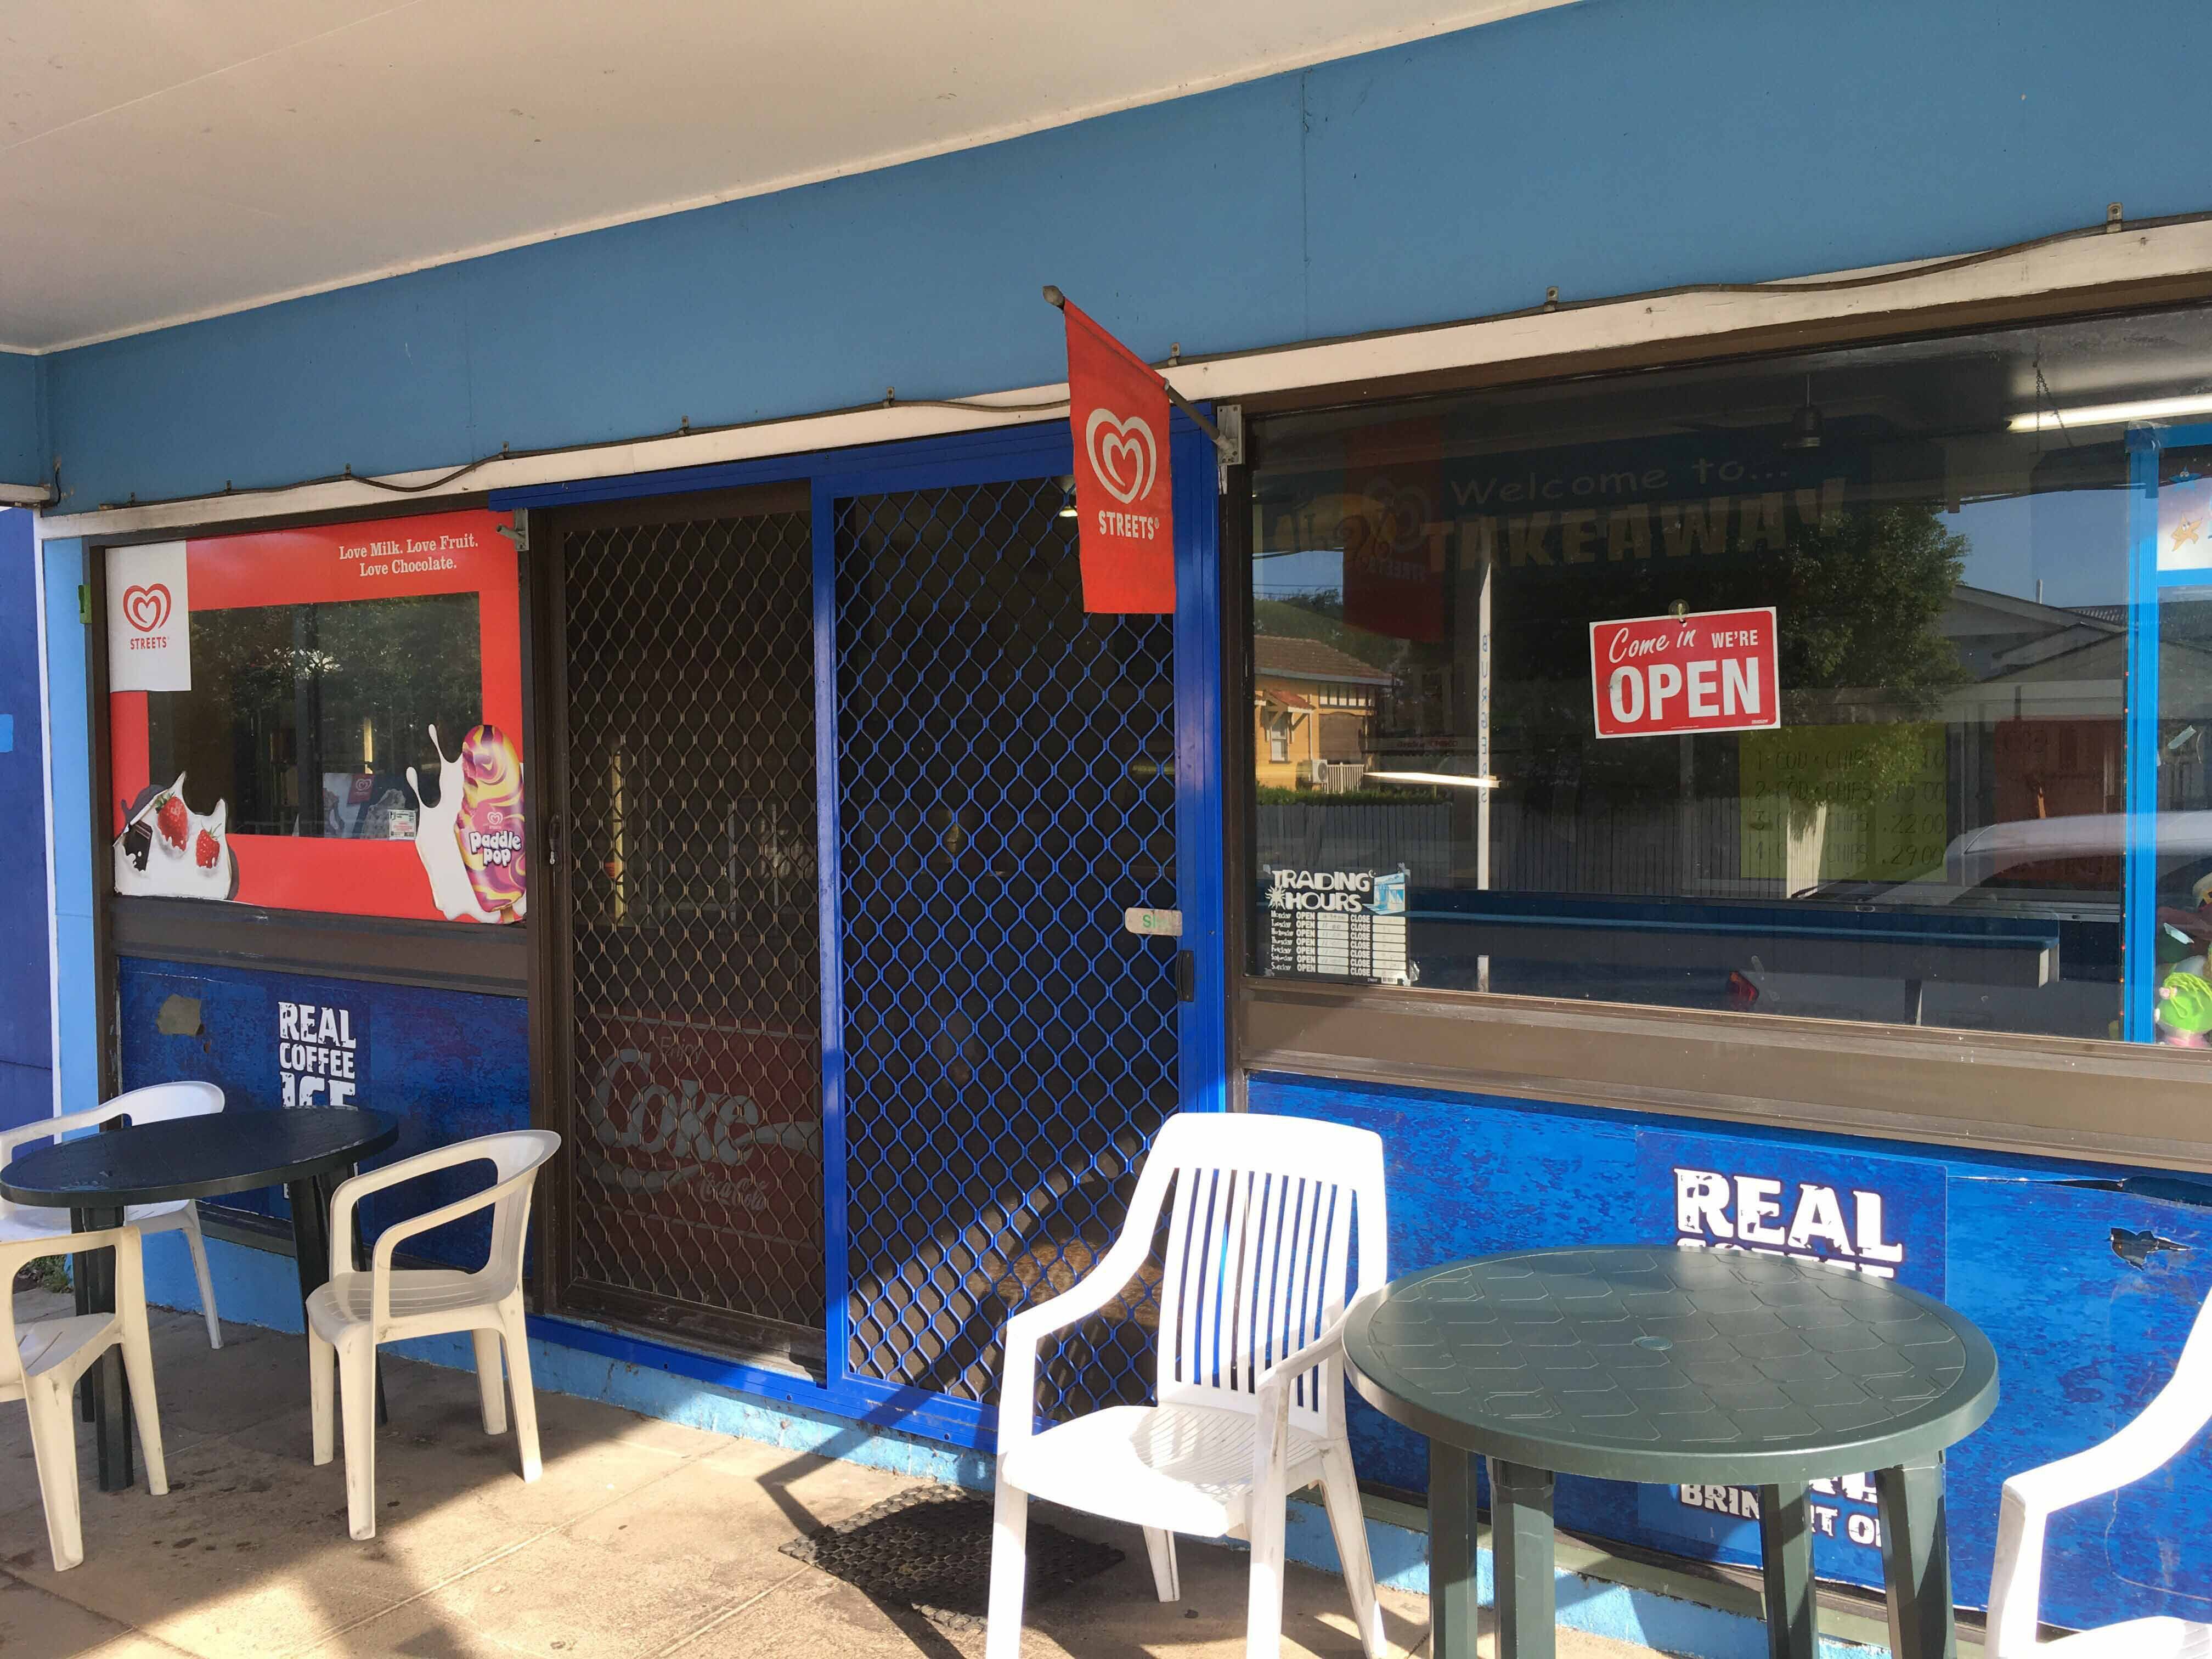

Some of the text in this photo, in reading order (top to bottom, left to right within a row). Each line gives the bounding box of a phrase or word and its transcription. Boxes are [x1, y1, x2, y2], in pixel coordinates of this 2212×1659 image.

[1451, 457, 1788, 507] Welcome to...
[1098, 510, 1155, 540] STREETS
[1421, 477, 1845, 571] TAKEAWAY
[339, 533, 478, 560] Love Milk. Love Fruit.
[359, 557, 457, 577] Love Chocolate.
[131, 636, 167, 650] STREETS
[1609, 622, 1758, 663] Come in WE'RE
[1609, 657, 1760, 723] OPEN
[1272, 870, 1370, 892] TRADING
[1285, 892, 1362, 913] HOURS
[1271, 910, 1291, 919] Monday
[1296, 911, 1316, 920] OPEN
[1350, 914, 1371, 923] CLOSE
[1271, 919, 1291, 928] Tuesday
[1296, 920, 1316, 929] OPEN
[1350, 923, 1371, 932] CLOSE
[1271, 936, 1293, 945] Thursday
[1296, 937, 1316, 946] OPEN
[1350, 940, 1371, 950] CLOSE
[1296, 929, 1316, 938] OPEN
[1350, 932, 1371, 941] CLOSE
[1271, 945, 1291, 953] Friday
[1296, 946, 1316, 955] OPEN
[1350, 950, 1371, 958] CLOSE
[1296, 955, 1316, 964] OPEN
[1350, 958, 1371, 968] CLOSE
[1271, 962, 1291, 970] Sunday
[1296, 963, 1316, 973] OPEN
[1350, 967, 1371, 977] CLOSE
[278, 1001, 356, 1048] REAL
[279, 1042, 356, 1079] COFFEE
[661, 1036, 705, 1064] Enjoy
[587, 1048, 759, 1166] Coke
[1673, 1168, 1903, 1262] REAL
